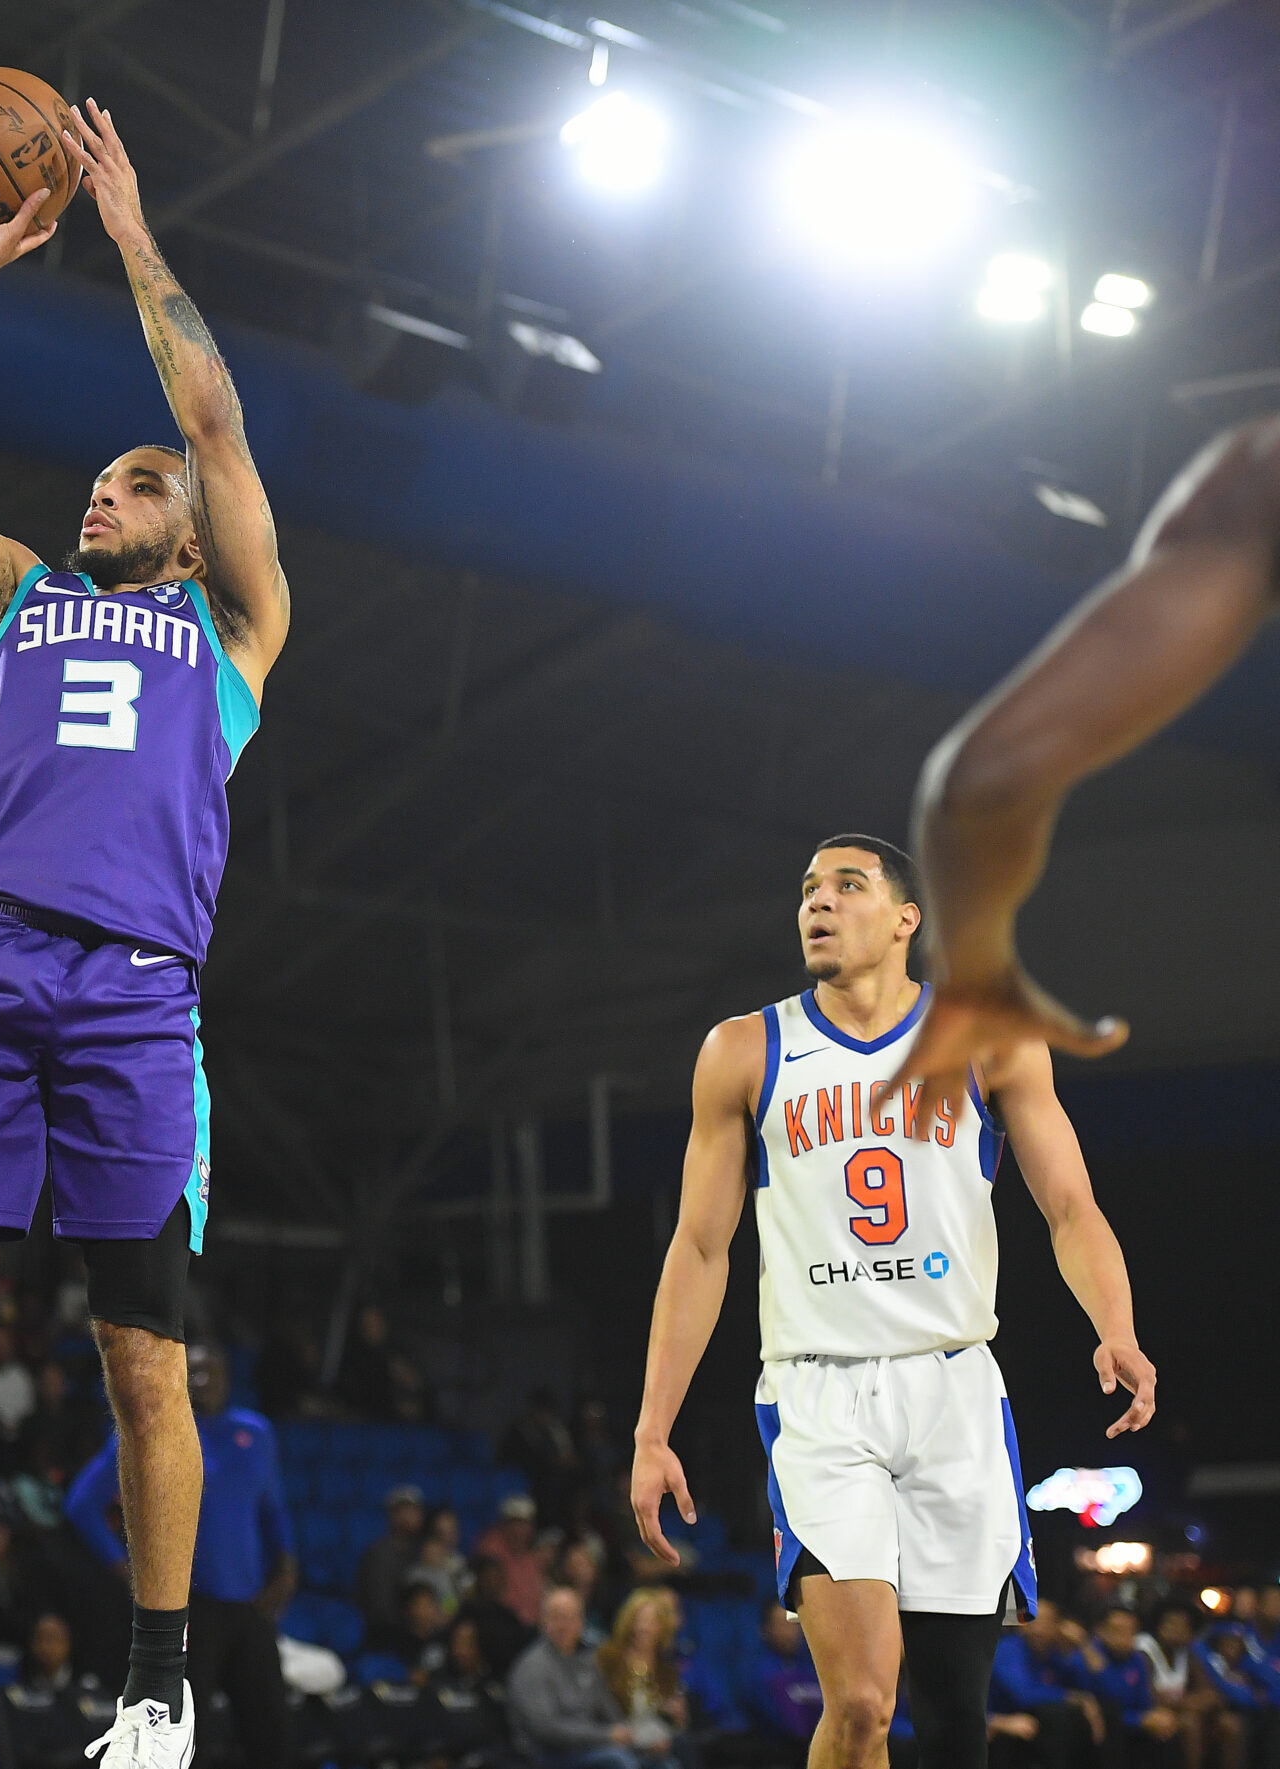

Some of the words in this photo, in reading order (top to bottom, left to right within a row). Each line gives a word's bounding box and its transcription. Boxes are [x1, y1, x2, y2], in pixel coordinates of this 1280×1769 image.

[16, 600, 200, 669] SWARM
[56, 658, 143, 752] 3
[784, 1080, 957, 1158] KNICKS
[844, 1147, 909, 1246] 9
[809, 1257, 917, 1286] CHASE
